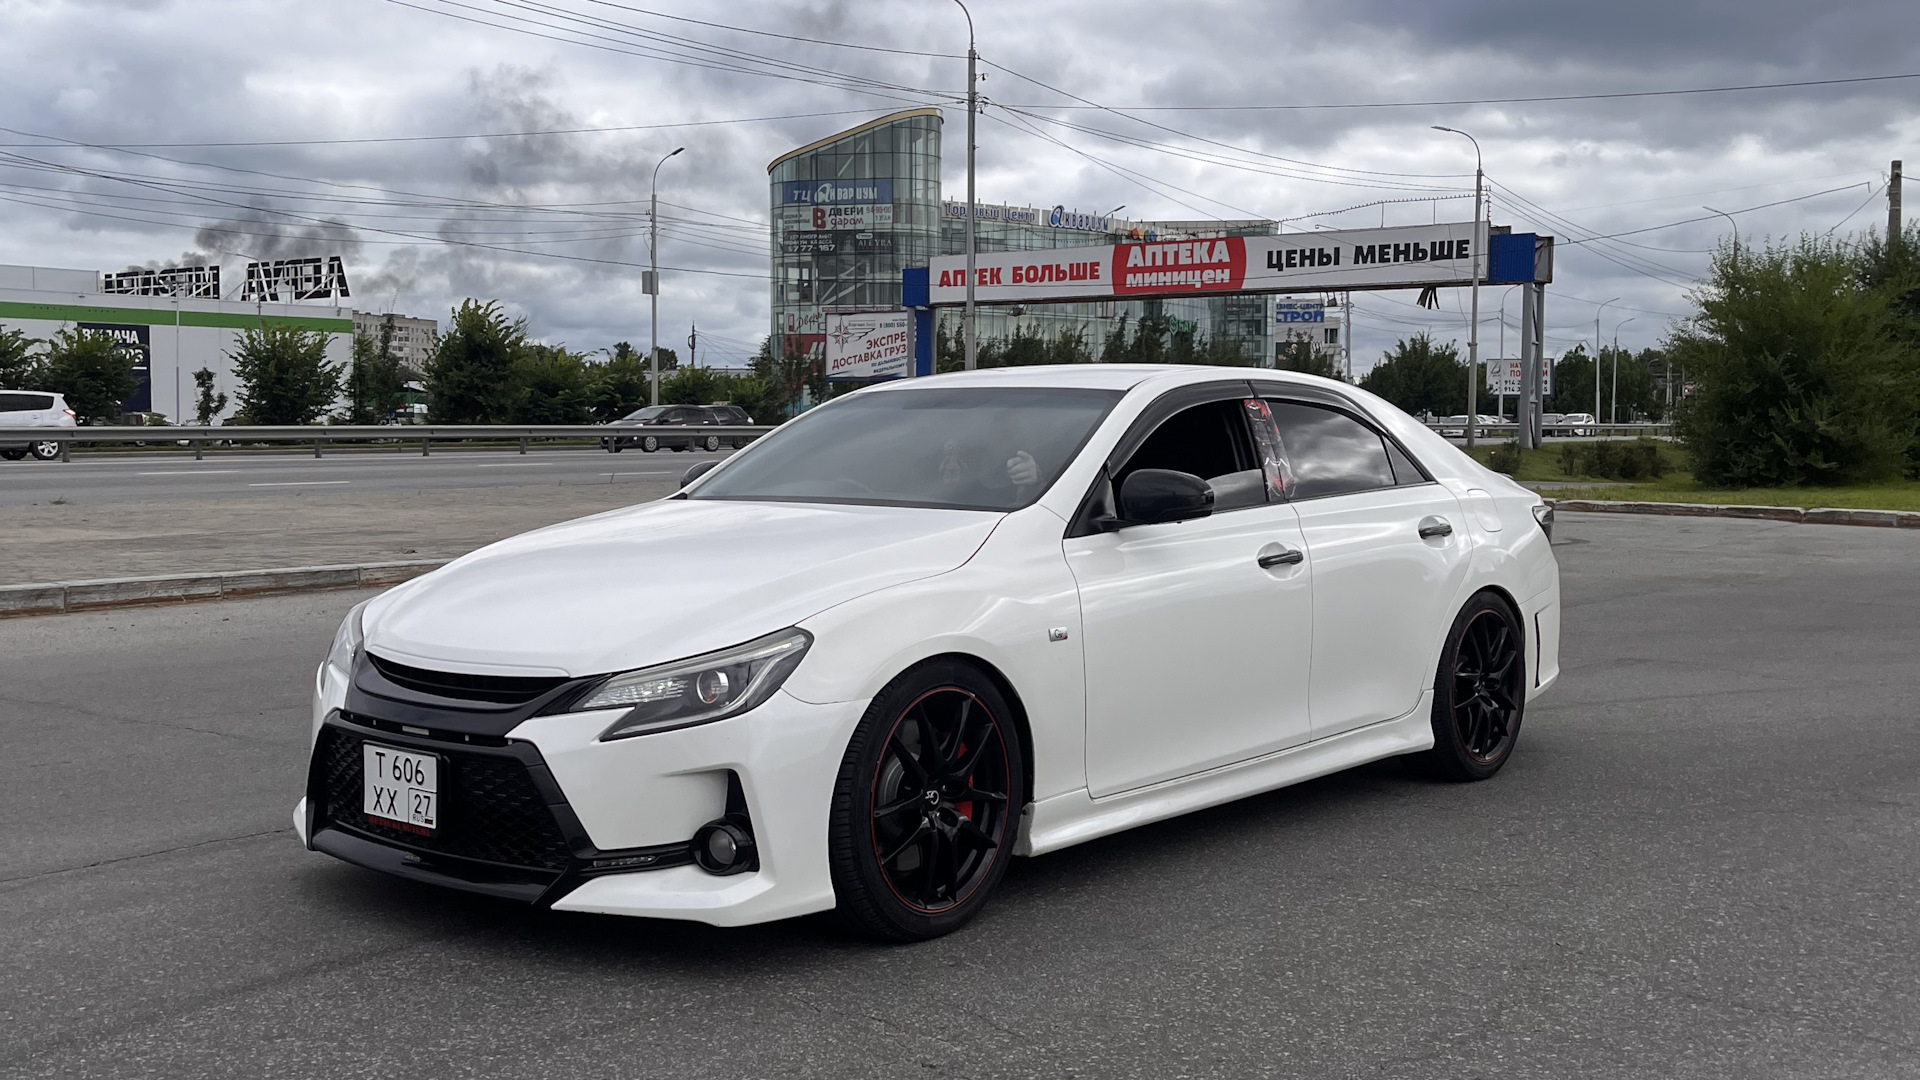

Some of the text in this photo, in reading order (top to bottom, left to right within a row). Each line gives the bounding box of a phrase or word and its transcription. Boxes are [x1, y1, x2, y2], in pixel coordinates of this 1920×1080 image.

[828, 207, 864, 218] ДВЕРИ
[945, 202, 1035, 222] Торовый Центр
[1126, 240, 1231, 268] АПТЕКА
[1266, 239, 1470, 272] ЦЕНЫ МЕНЬШЕ
[939, 261, 1100, 287] АПЕК БОЛЬШЕ
[1125, 268, 1231, 289] миницен
[866, 331, 907, 350] ЭКСПРЕ
[832, 344, 907, 370] ДОСТАВКА ГРУЗ
[392, 755, 425, 786] 606
[414, 793, 431, 816] 27
[412, 813, 424, 823] RUS
